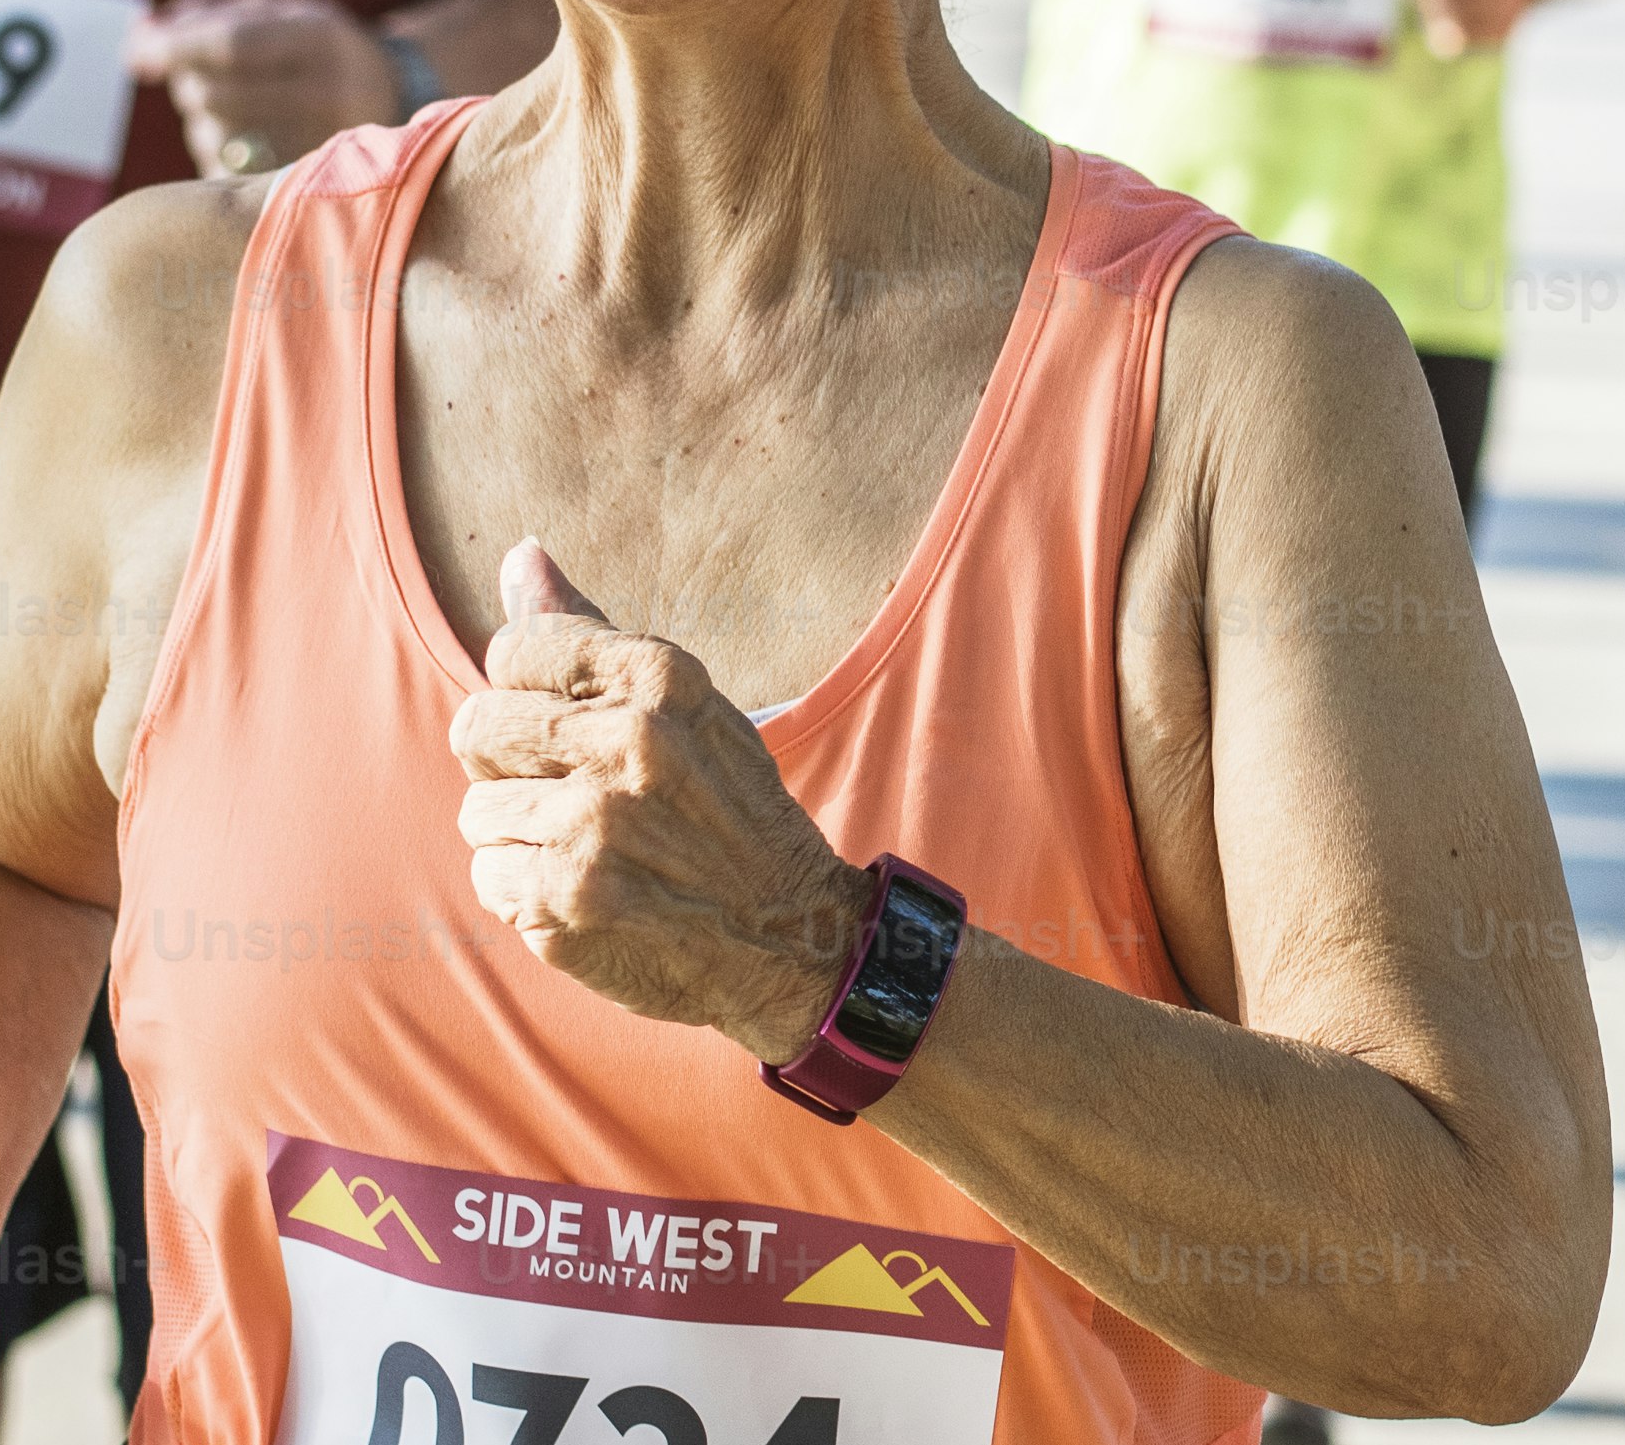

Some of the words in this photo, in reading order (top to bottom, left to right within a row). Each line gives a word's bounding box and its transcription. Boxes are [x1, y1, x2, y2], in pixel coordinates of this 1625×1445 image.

[452, 1188, 583, 1256] SIDE
[607, 1207, 778, 1273] WEST
[530, 1255, 688, 1294] MOUNTAIN
